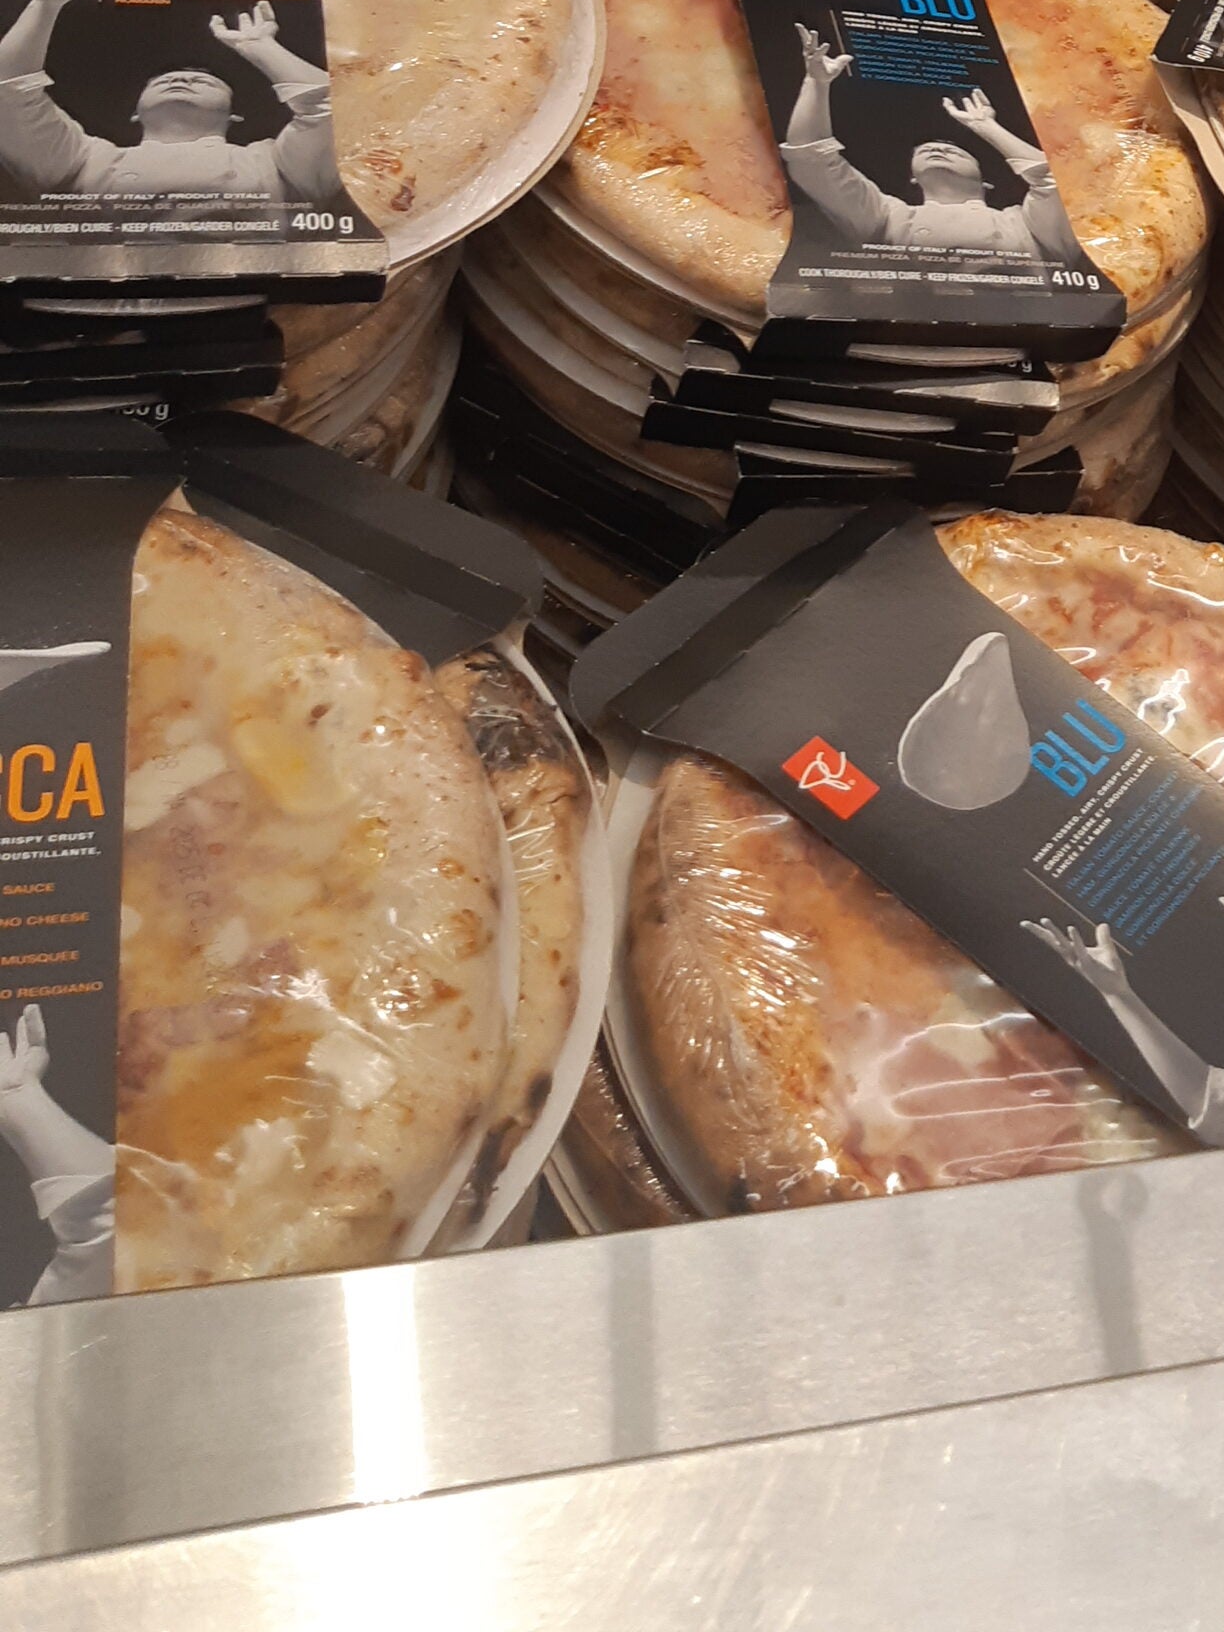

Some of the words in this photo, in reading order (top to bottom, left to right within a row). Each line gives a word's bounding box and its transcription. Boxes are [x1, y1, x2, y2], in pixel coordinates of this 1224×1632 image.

[169, 192, 221, 200] PRODUIT
[81, 222, 112, 232] CUIRE
[121, 222, 147, 232] KEEP
[150, 221, 231, 232] FROZEN/GARDER
[291, 213, 333, 230] 400
[338, 216, 353, 233] g
[1051, 270, 1086, 287] 410
[1088, 275, 1101, 290] g
[1028, 697, 1127, 798] BLU
[0, 739, 104, 823] CA
[1031, 840, 1054, 864] HAND
[1096, 769, 1122, 797] CRISPY
[1119, 747, 1144, 772] CRUST
[1093, 807, 1105, 819] ET
[46, 831, 95, 842] CRUST
[1083, 833, 1095, 846] LA
[1092, 816, 1112, 836] MAIN
[2, 882, 55, 895] SAUCE
[26, 912, 90, 926] CHEESE
[15, 980, 103, 997] REGGIANO
